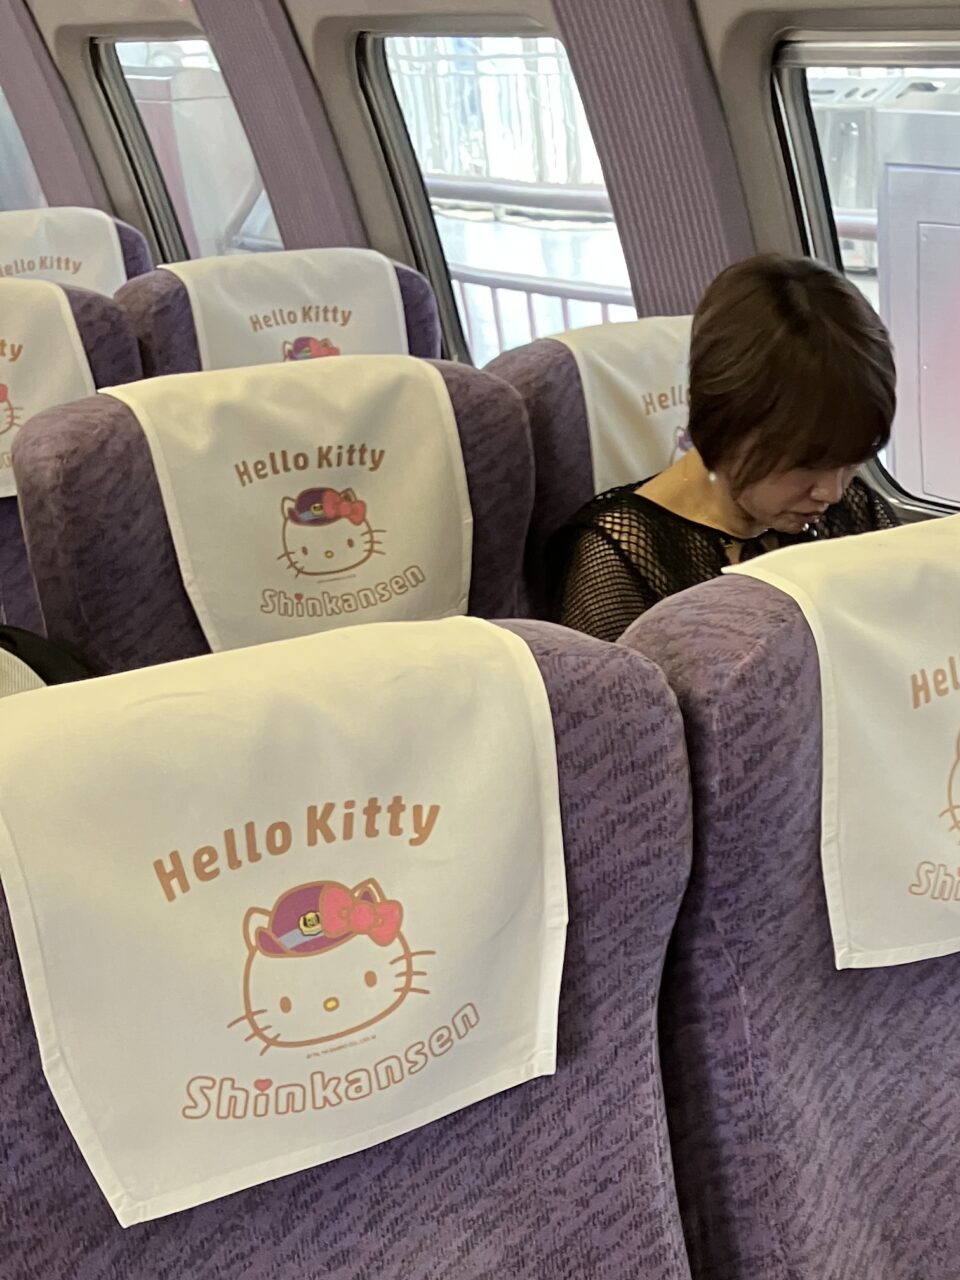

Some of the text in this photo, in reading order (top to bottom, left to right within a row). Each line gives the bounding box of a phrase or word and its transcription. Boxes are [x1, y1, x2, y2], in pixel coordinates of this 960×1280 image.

[39, 255, 82, 275] Kitty
[249, 304, 352, 333] Hello Kitty
[234, 443, 386, 487] Hello Kitty
[260, 564, 426, 617] Shinkansen
[152, 795, 441, 902] Hello Kitty
[182, 1002, 481, 1121] Shinkansen
